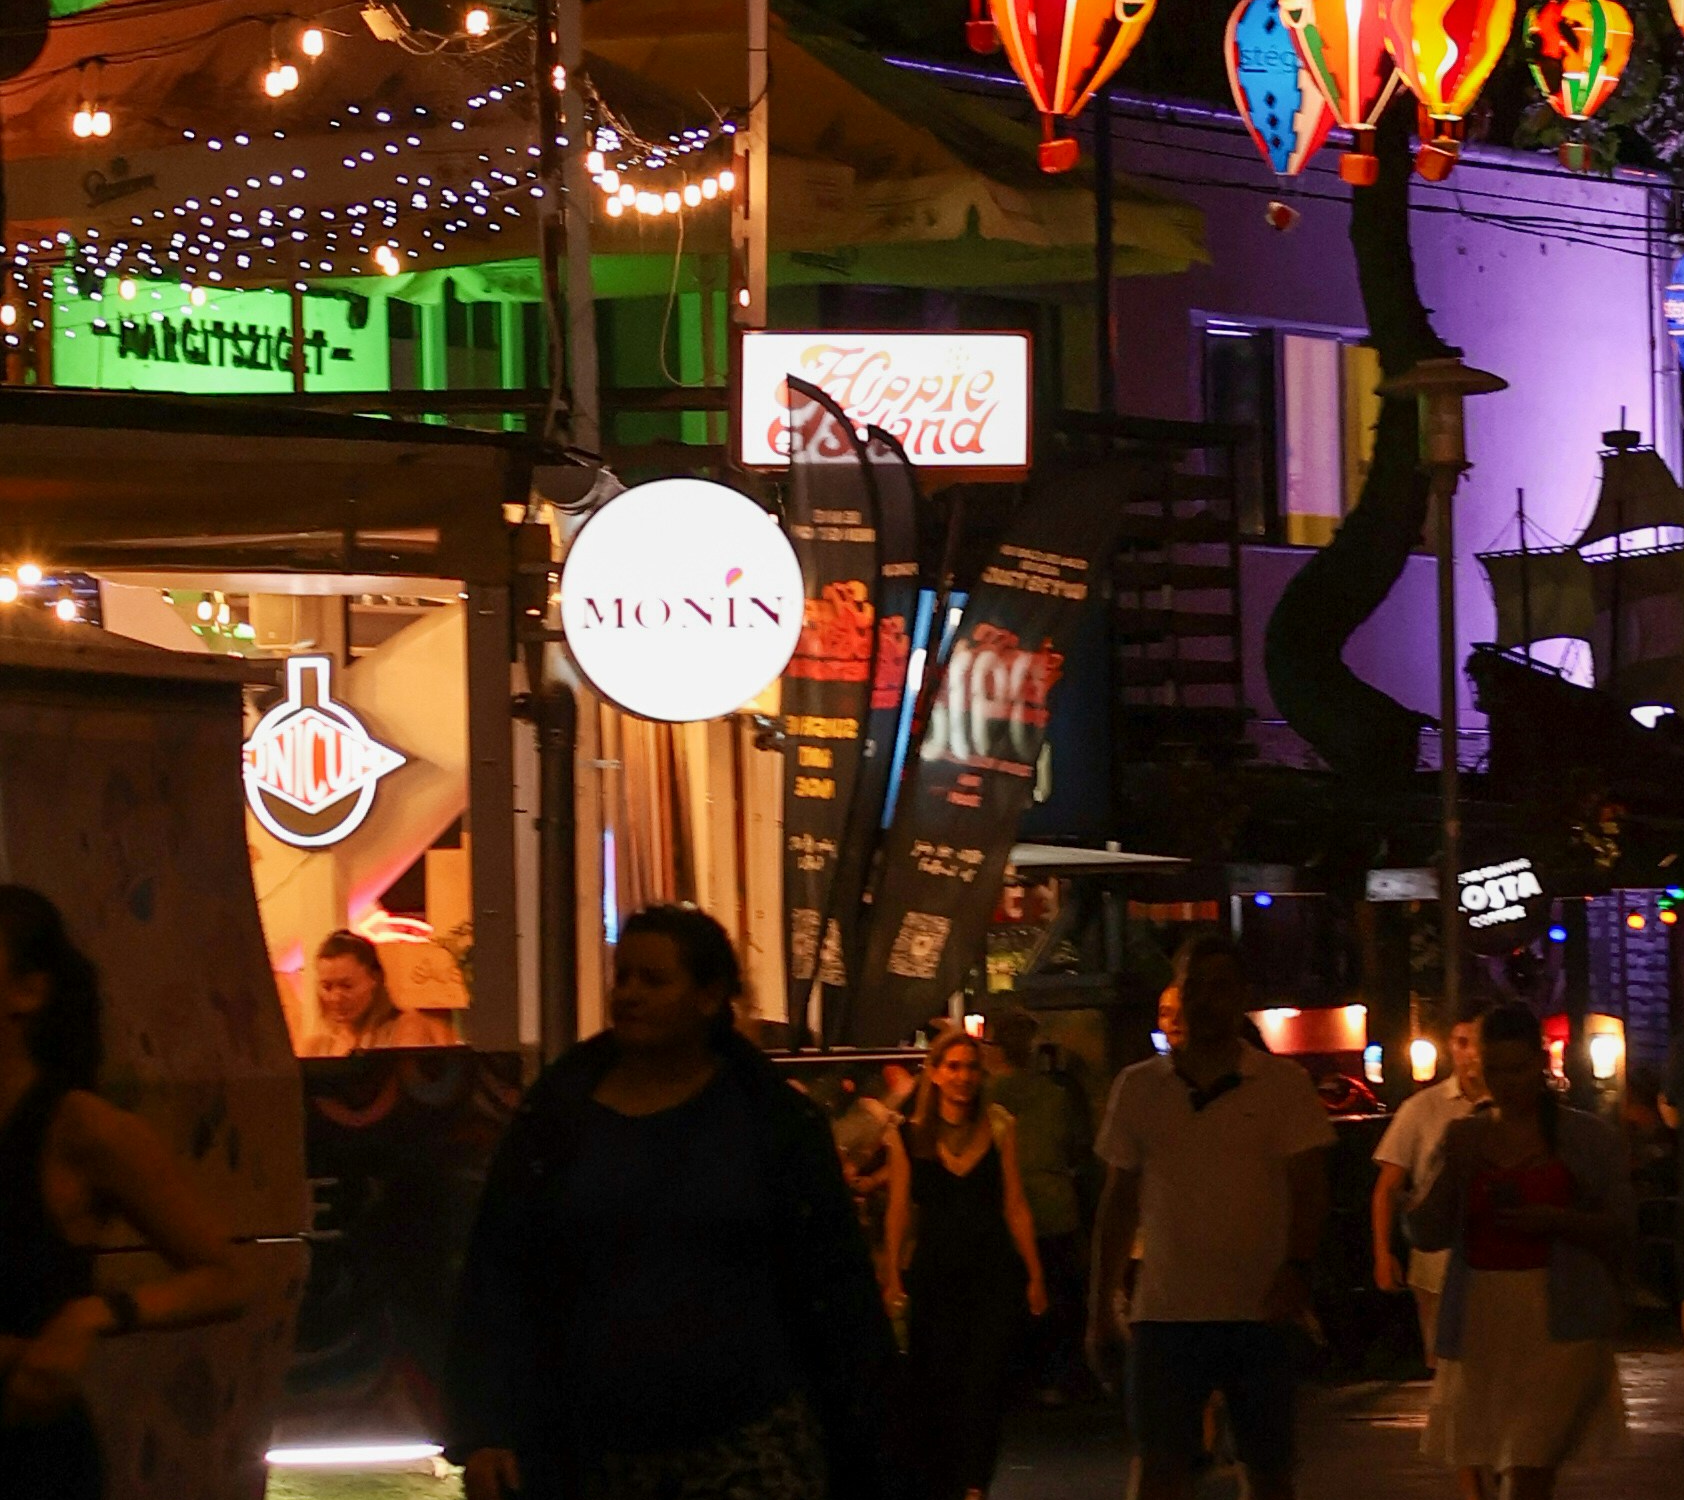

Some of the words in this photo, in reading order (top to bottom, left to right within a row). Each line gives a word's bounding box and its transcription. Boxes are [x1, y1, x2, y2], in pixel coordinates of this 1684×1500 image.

[801, 344, 995, 417] Hippie
[584, 597, 782, 629] MONIN
[1458, 871, 1543, 911] OSTA
